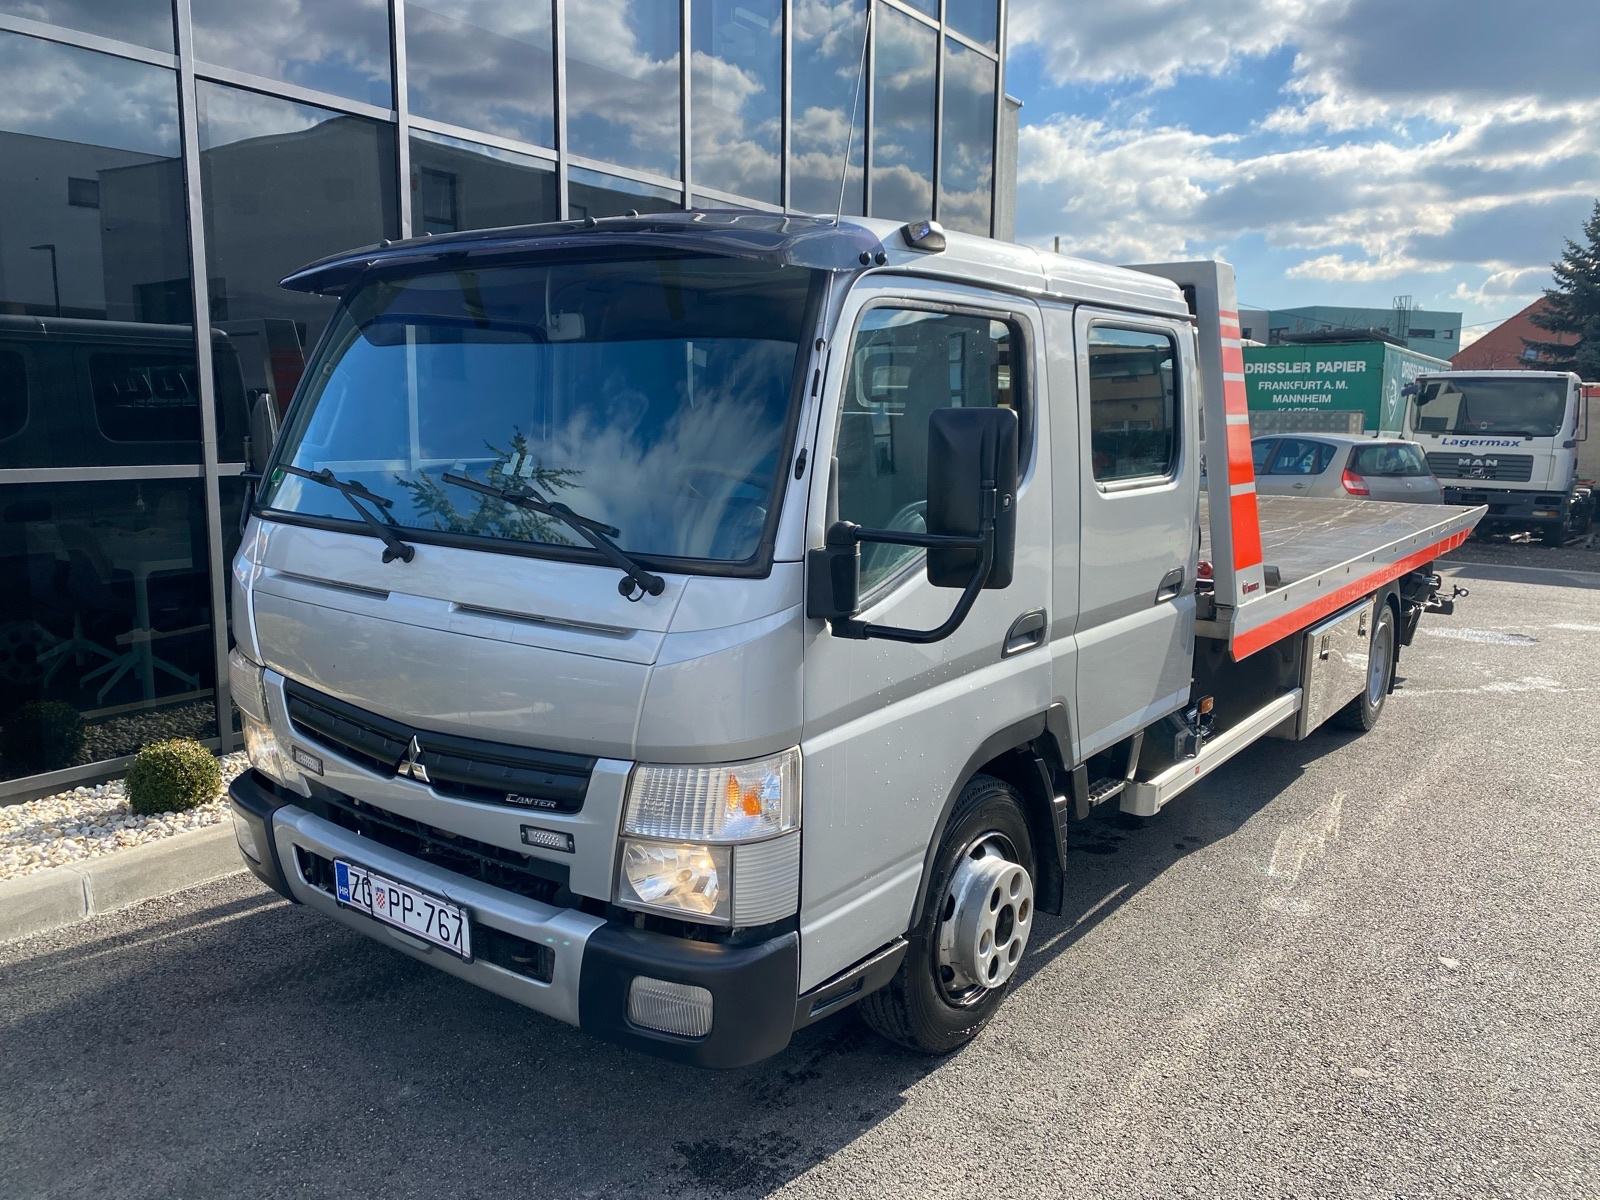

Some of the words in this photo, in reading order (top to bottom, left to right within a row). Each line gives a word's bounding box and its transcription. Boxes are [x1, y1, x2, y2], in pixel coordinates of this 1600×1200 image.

[1244, 361, 1312, 374] DRISSLER
[1316, 360, 1367, 373] PAPIER
[1258, 380, 1323, 390] FRANKFURT
[1272, 394, 1332, 403] MANNHEIM
[1441, 437, 1521, 448] Lagermax
[1458, 458, 1498, 467] MAN
[338, 885, 349, 897] HR
[350, 872, 372, 907] ZG
[388, 888, 463, 946] PP-767
